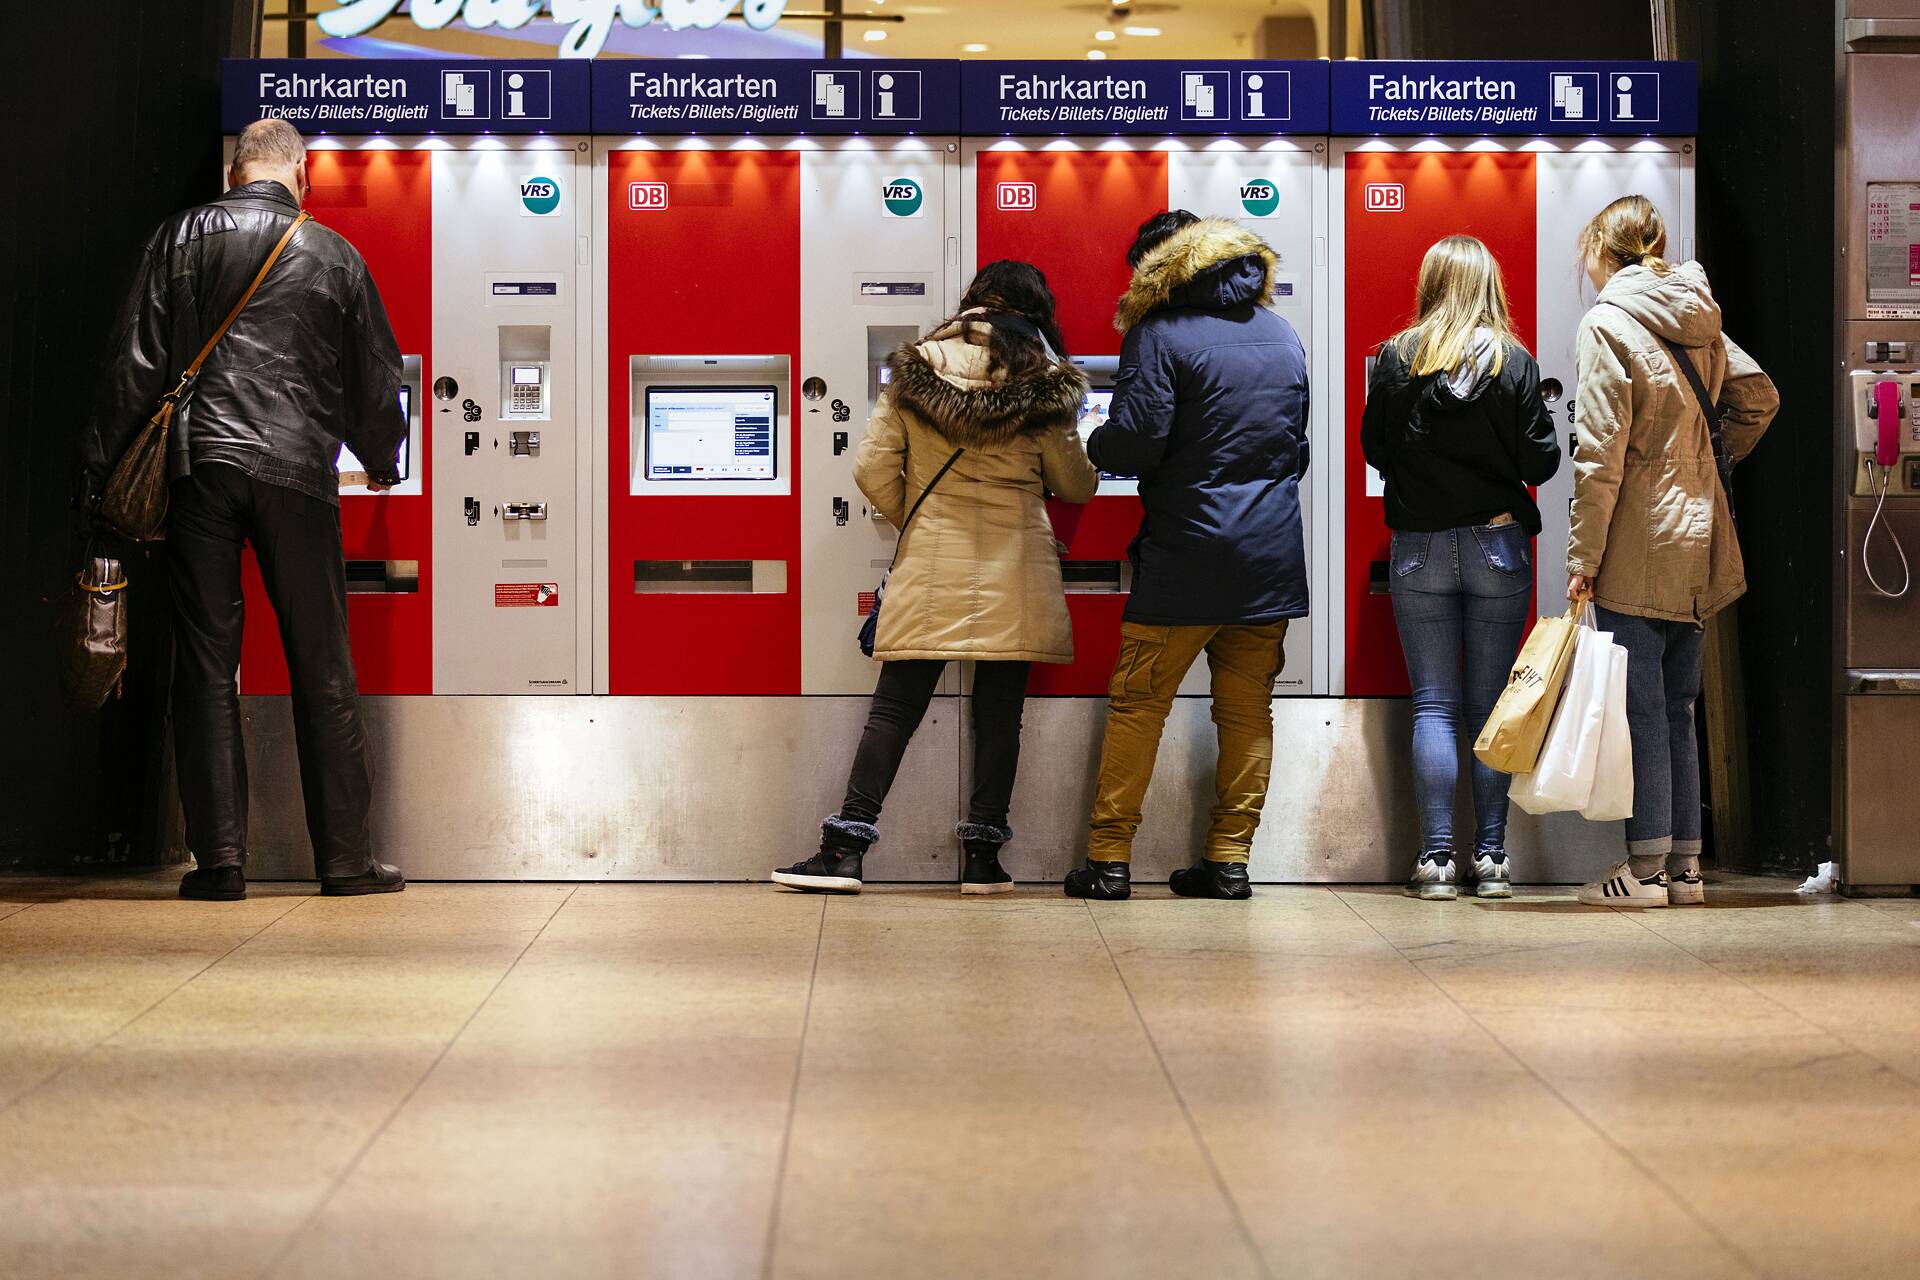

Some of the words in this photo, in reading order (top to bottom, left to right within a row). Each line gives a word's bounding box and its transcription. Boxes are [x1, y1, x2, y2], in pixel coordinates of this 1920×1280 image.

[259, 73, 407, 98] Fahrkarten
[630, 73, 778, 98] Fahrkarten
[1000, 74, 1148, 99] Fahrkarten
[1369, 75, 1516, 100] Fahrkarten
[521, 185, 551, 197] VRS
[634, 187, 663, 205] DB
[883, 187, 913, 198] VRS
[1002, 188, 1031, 205] DB
[1240, 187, 1270, 198] VRS
[1371, 188, 1399, 206] DB
